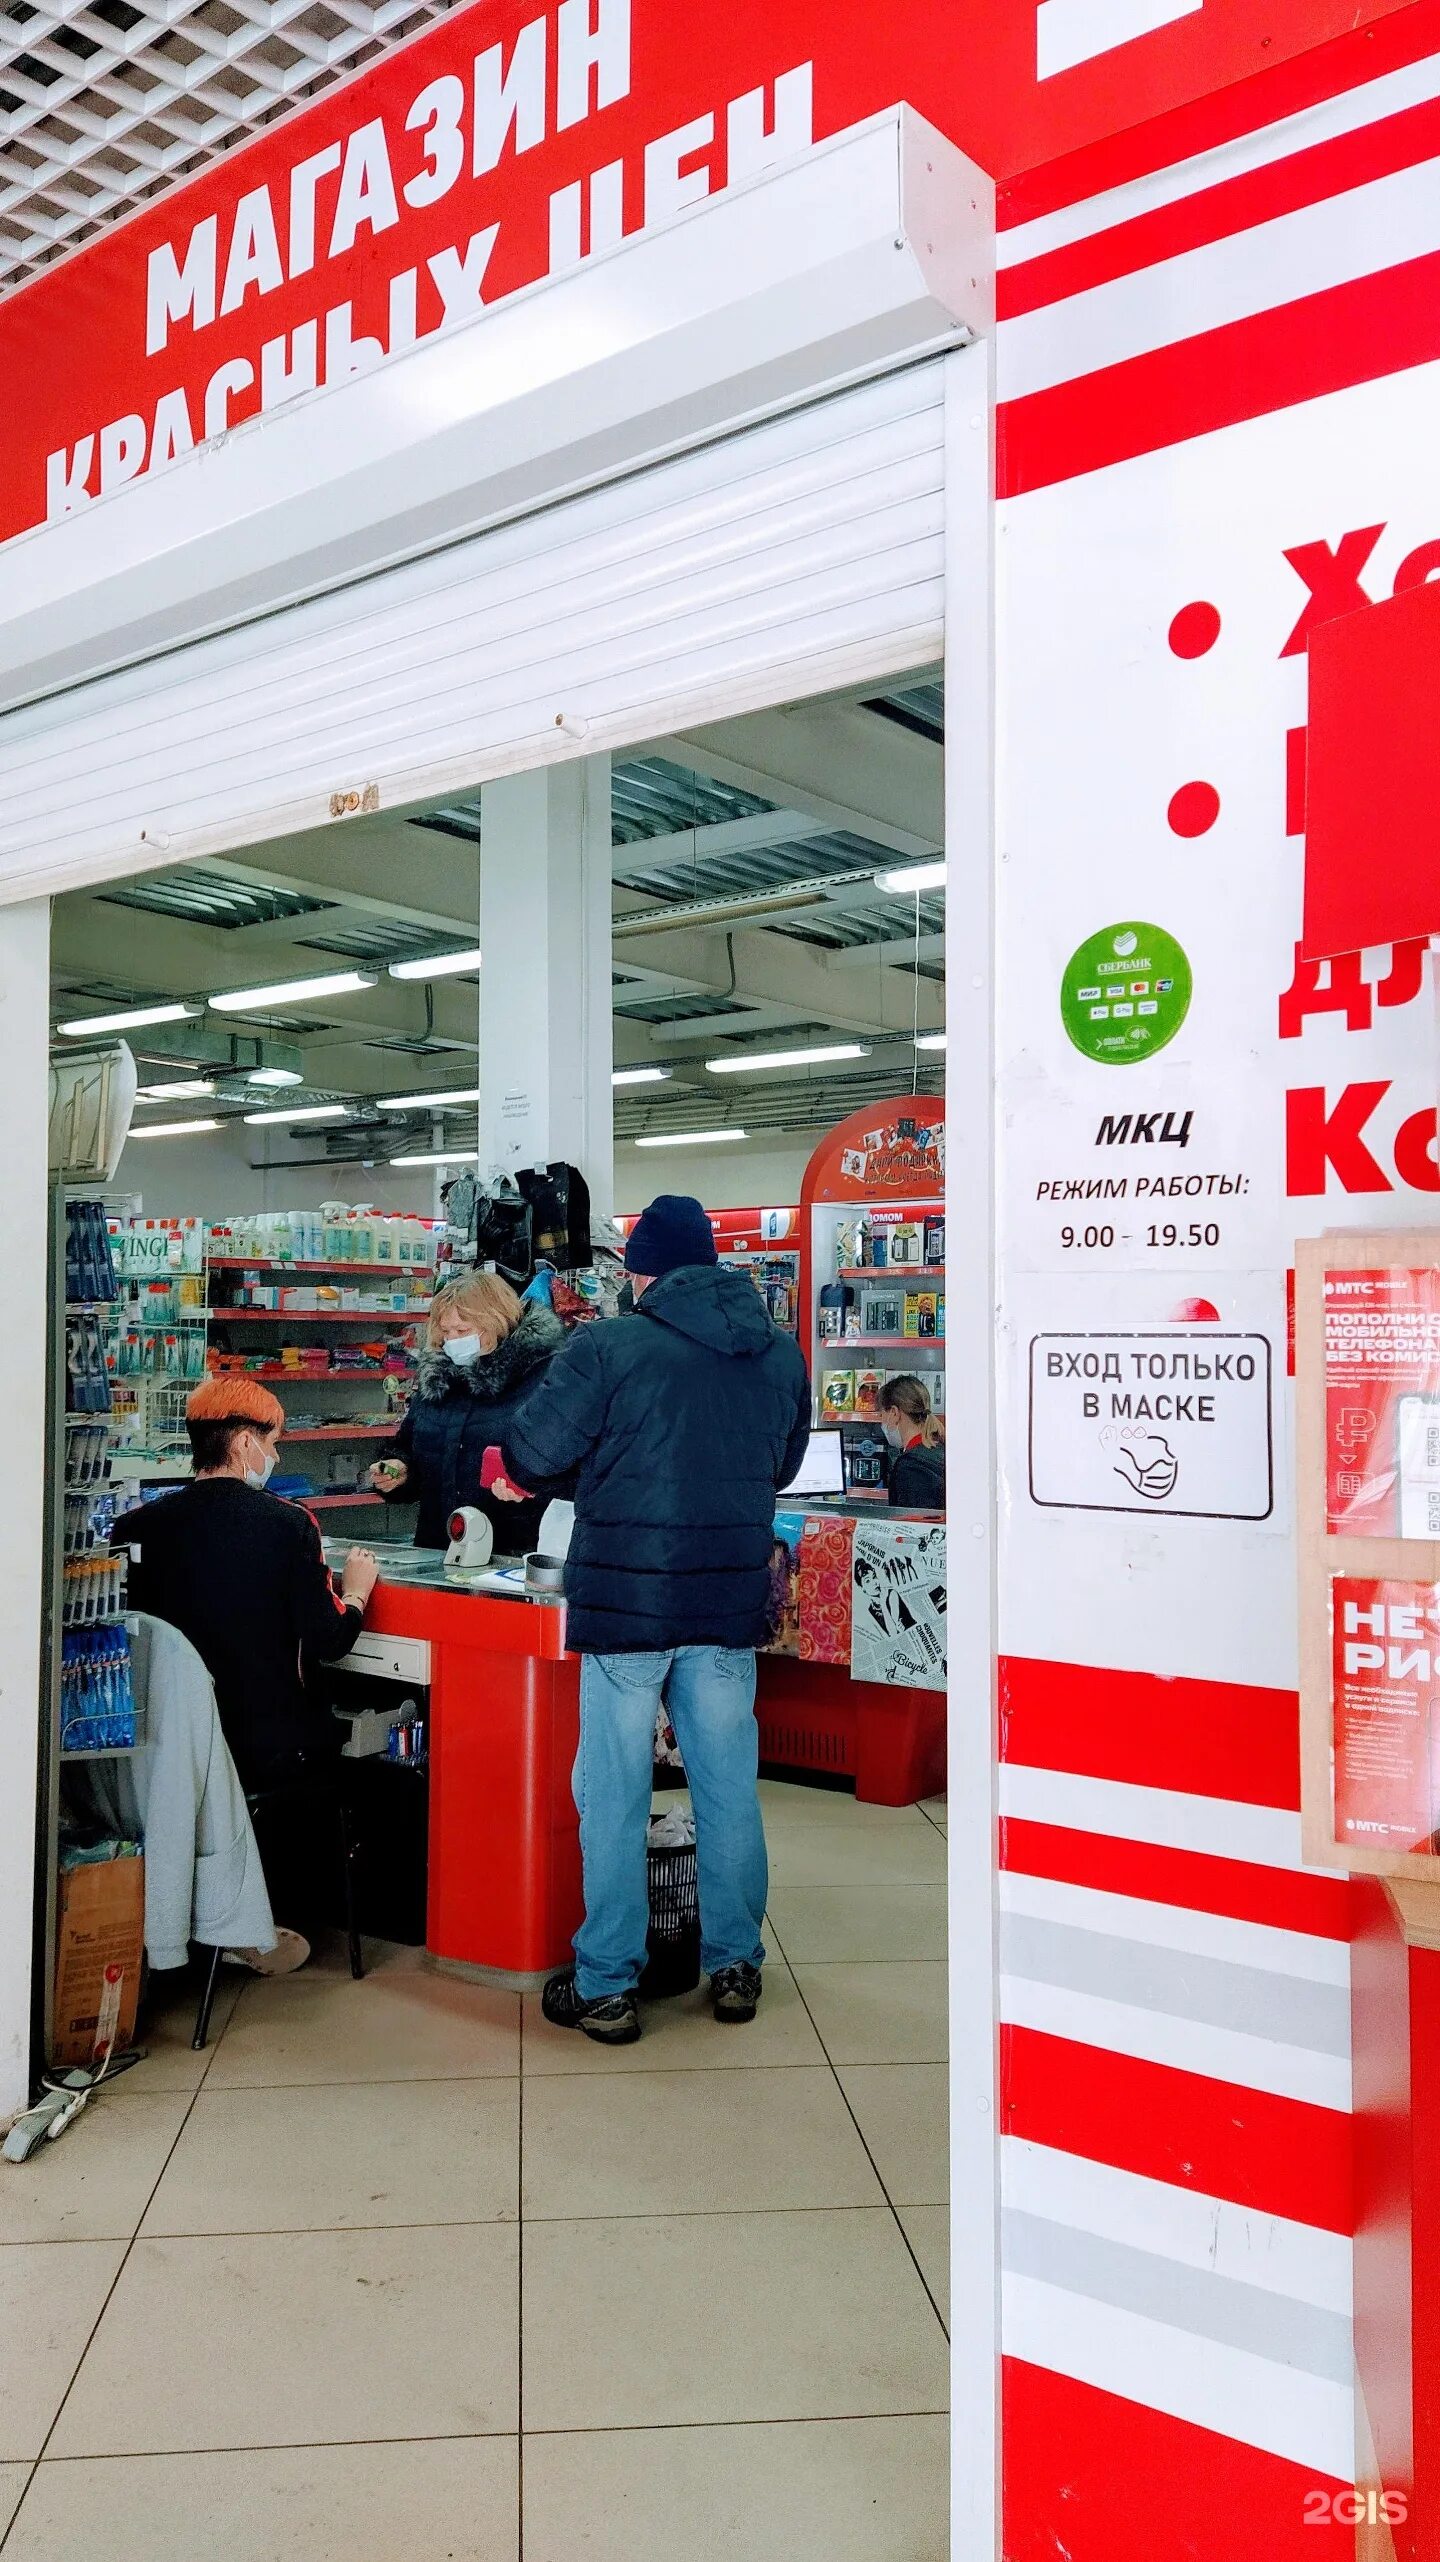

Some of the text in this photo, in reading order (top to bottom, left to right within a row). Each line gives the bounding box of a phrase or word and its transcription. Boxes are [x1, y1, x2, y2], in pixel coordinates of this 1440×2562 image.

[145, 0, 632, 356] МАГАЗИН
[1097, 958, 1152, 973] СБЕРБАНК
[1094, 1110, 1195, 1148] МКЦ
[1036, 1173, 1251, 1201] РЕЖИМ РАБОТЫ:
[1060, 1225, 1115, 1248] 9.00
[1146, 1223, 1221, 1248] 19.50
[1335, 1282, 1374, 1295] МТС
[1325, 1312, 1426, 1326] ПОПОЛНИ
[1325, 1337, 1438, 1350] ТЕЛЕФОНА
[1046, 1352, 1256, 1384] ВХОД ТОЛЬКО
[1325, 1350, 1363, 1363] БЕЗ
[1083, 1392, 1216, 1422] В МАСКЕ
[892, 1649, 929, 1676] Bicycle
[1356, 1820, 1389, 1834] МТС
